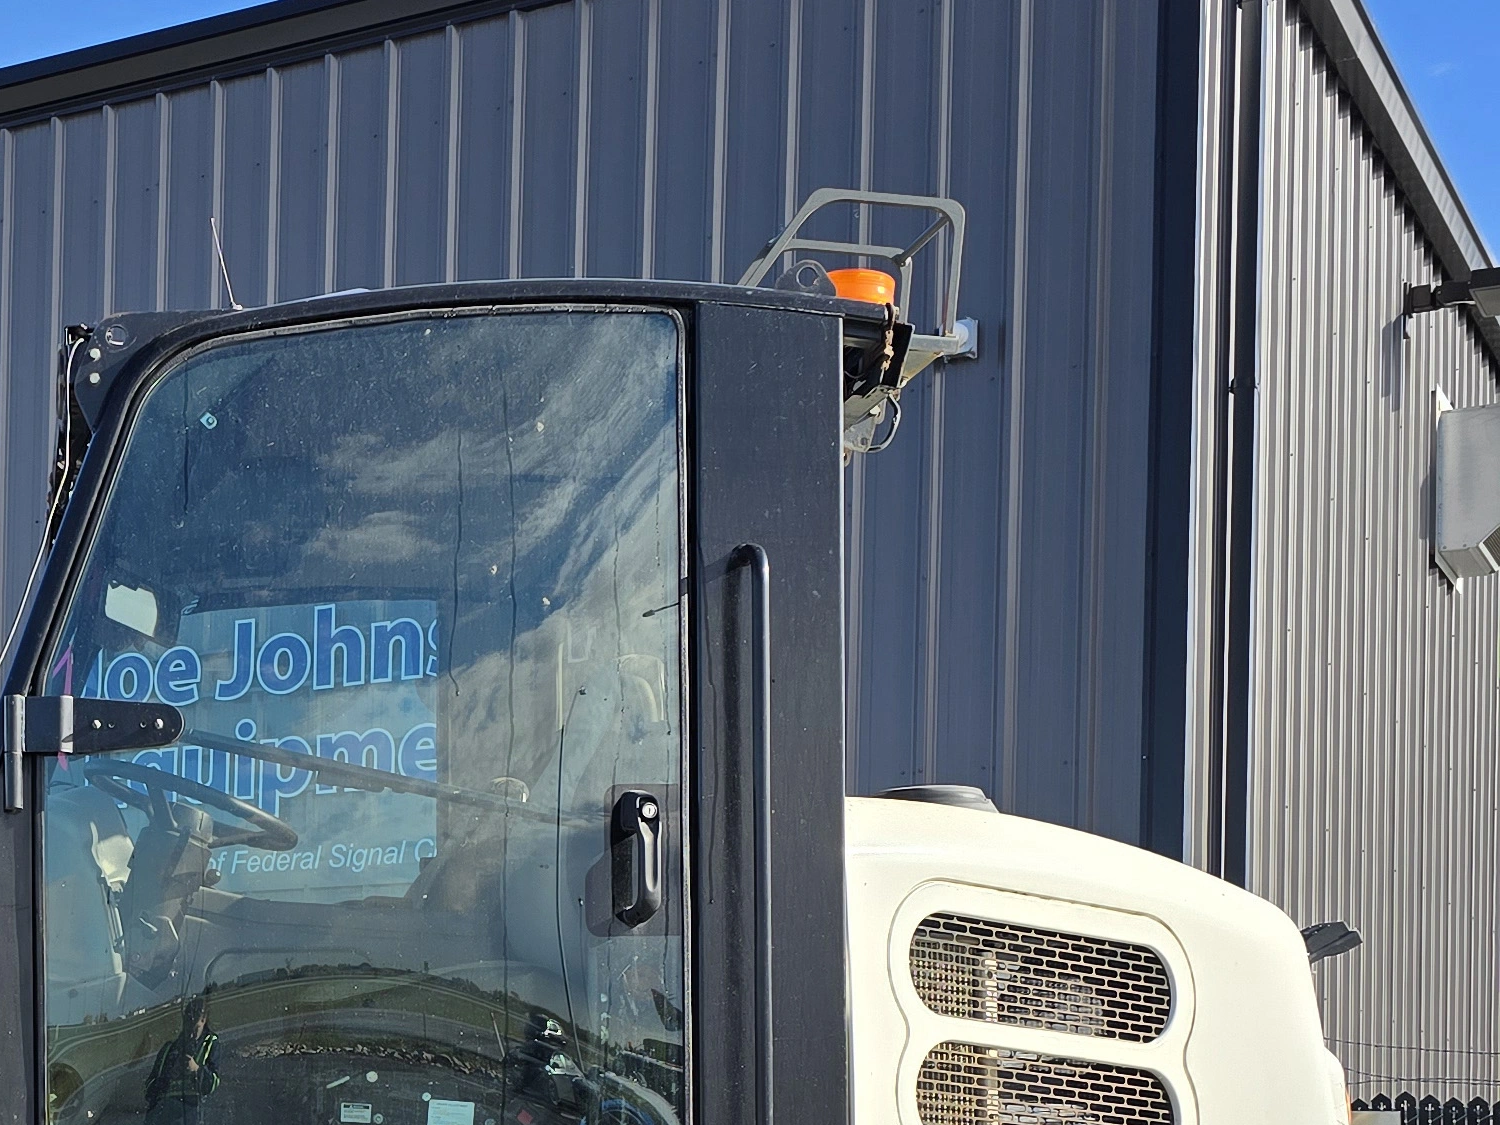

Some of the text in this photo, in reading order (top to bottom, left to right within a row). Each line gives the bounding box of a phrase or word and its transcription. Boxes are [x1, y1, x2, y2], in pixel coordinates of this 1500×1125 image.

[215, 602, 438, 701] John
[231, 844, 321, 874] Federal
[328, 840, 406, 873] Signal
